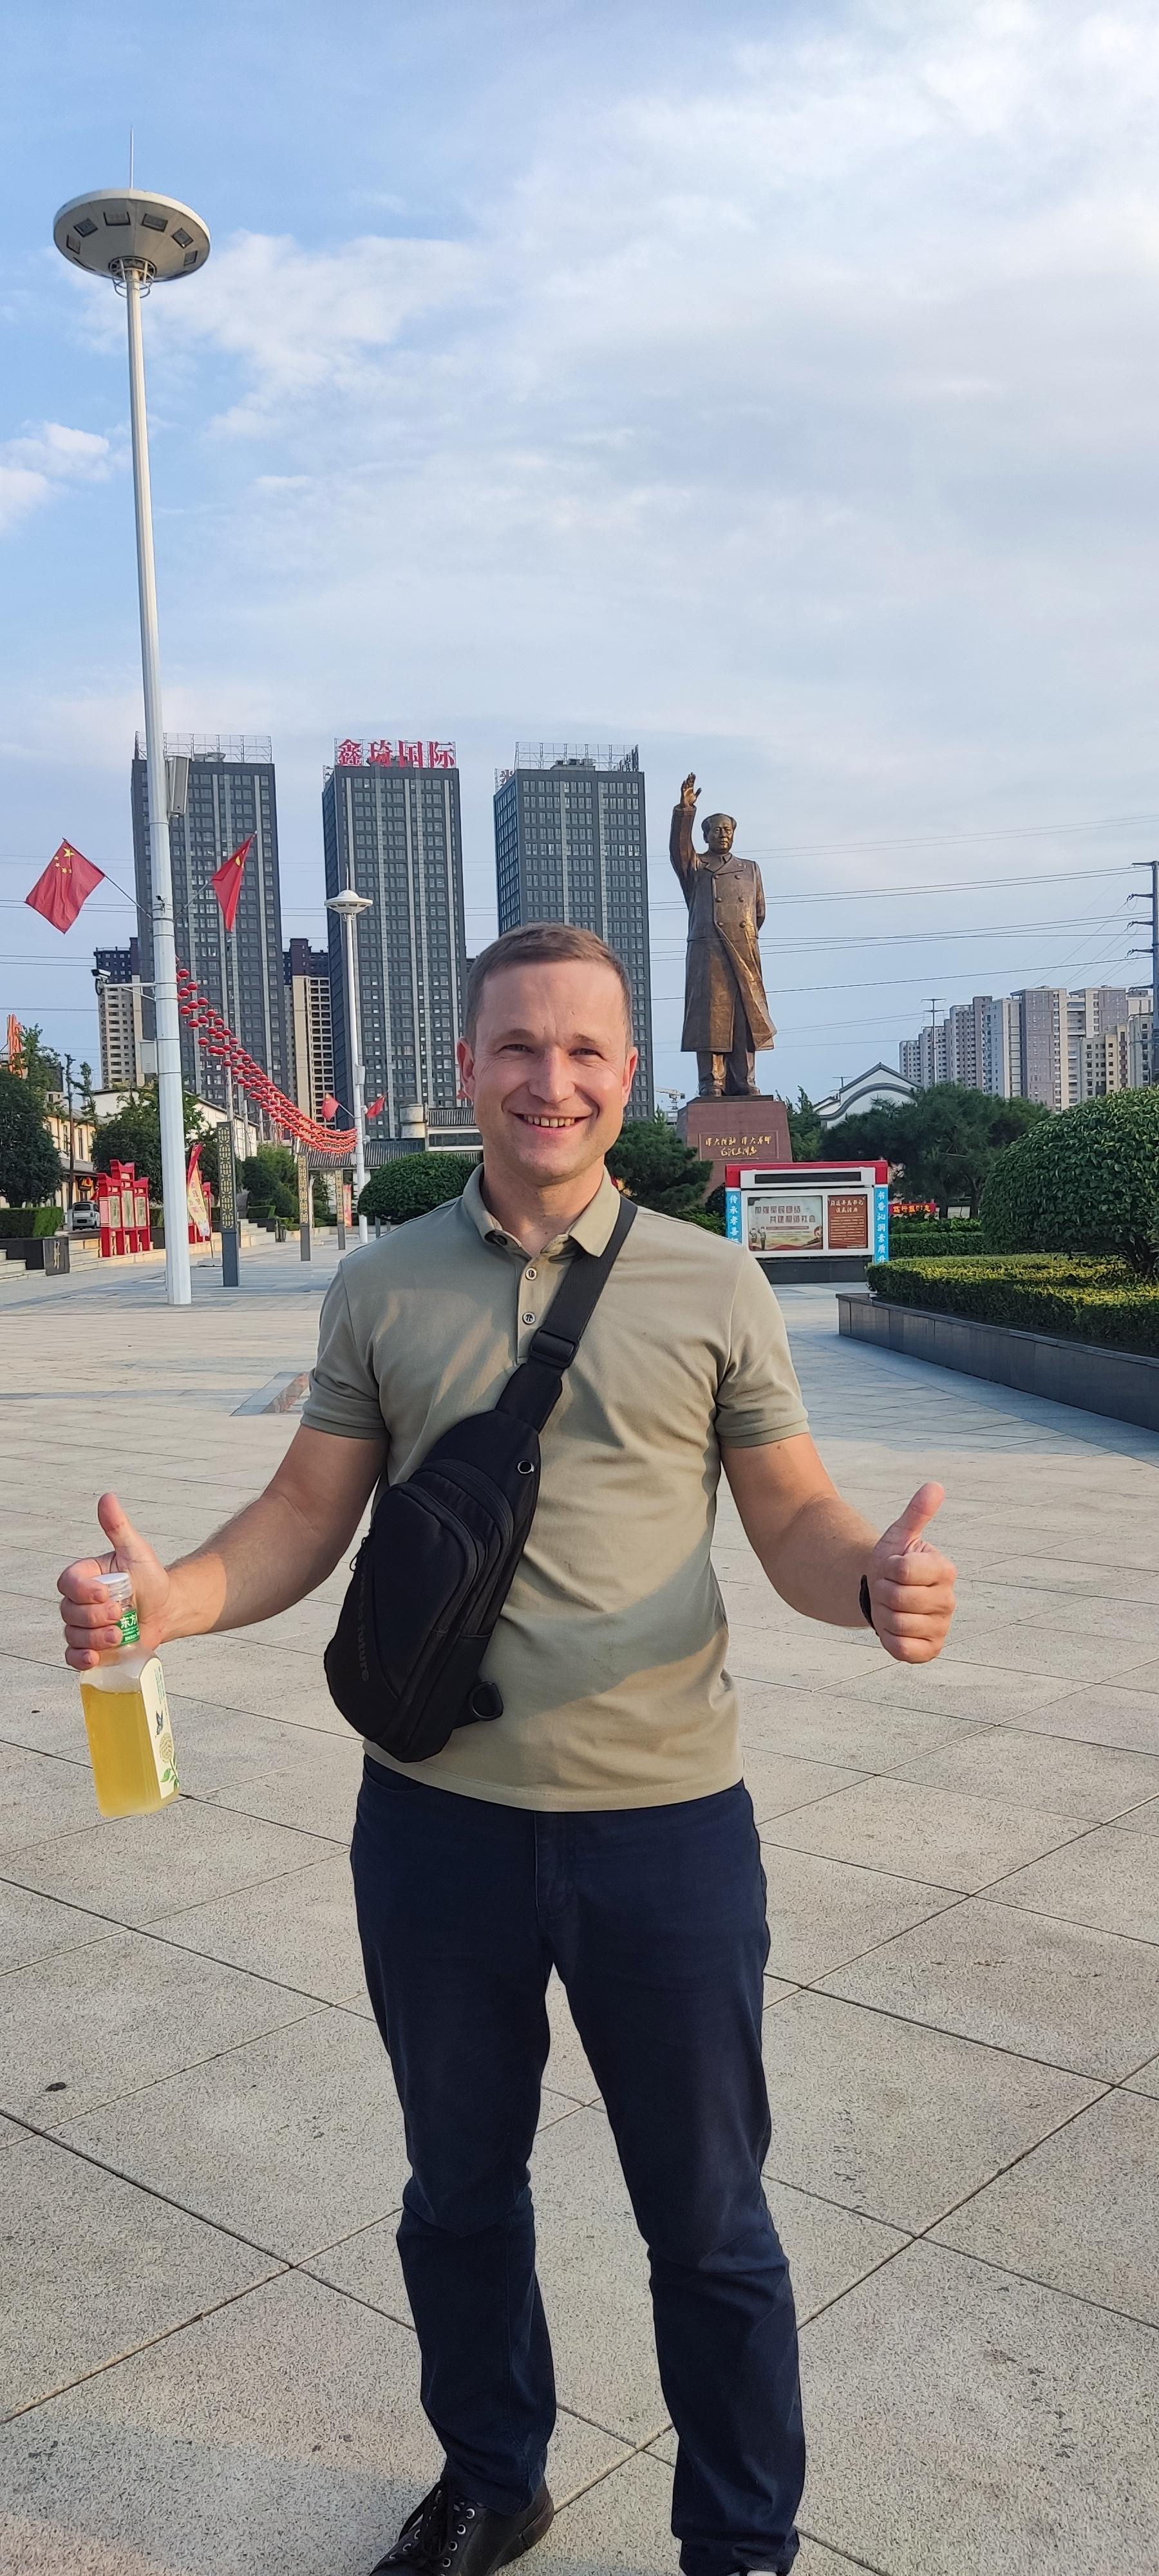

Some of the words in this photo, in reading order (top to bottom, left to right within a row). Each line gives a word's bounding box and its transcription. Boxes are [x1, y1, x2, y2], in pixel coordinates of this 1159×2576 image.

[337, 739, 455, 769] 鑫琦国际
[120, 1612, 138, 1629] 东方
